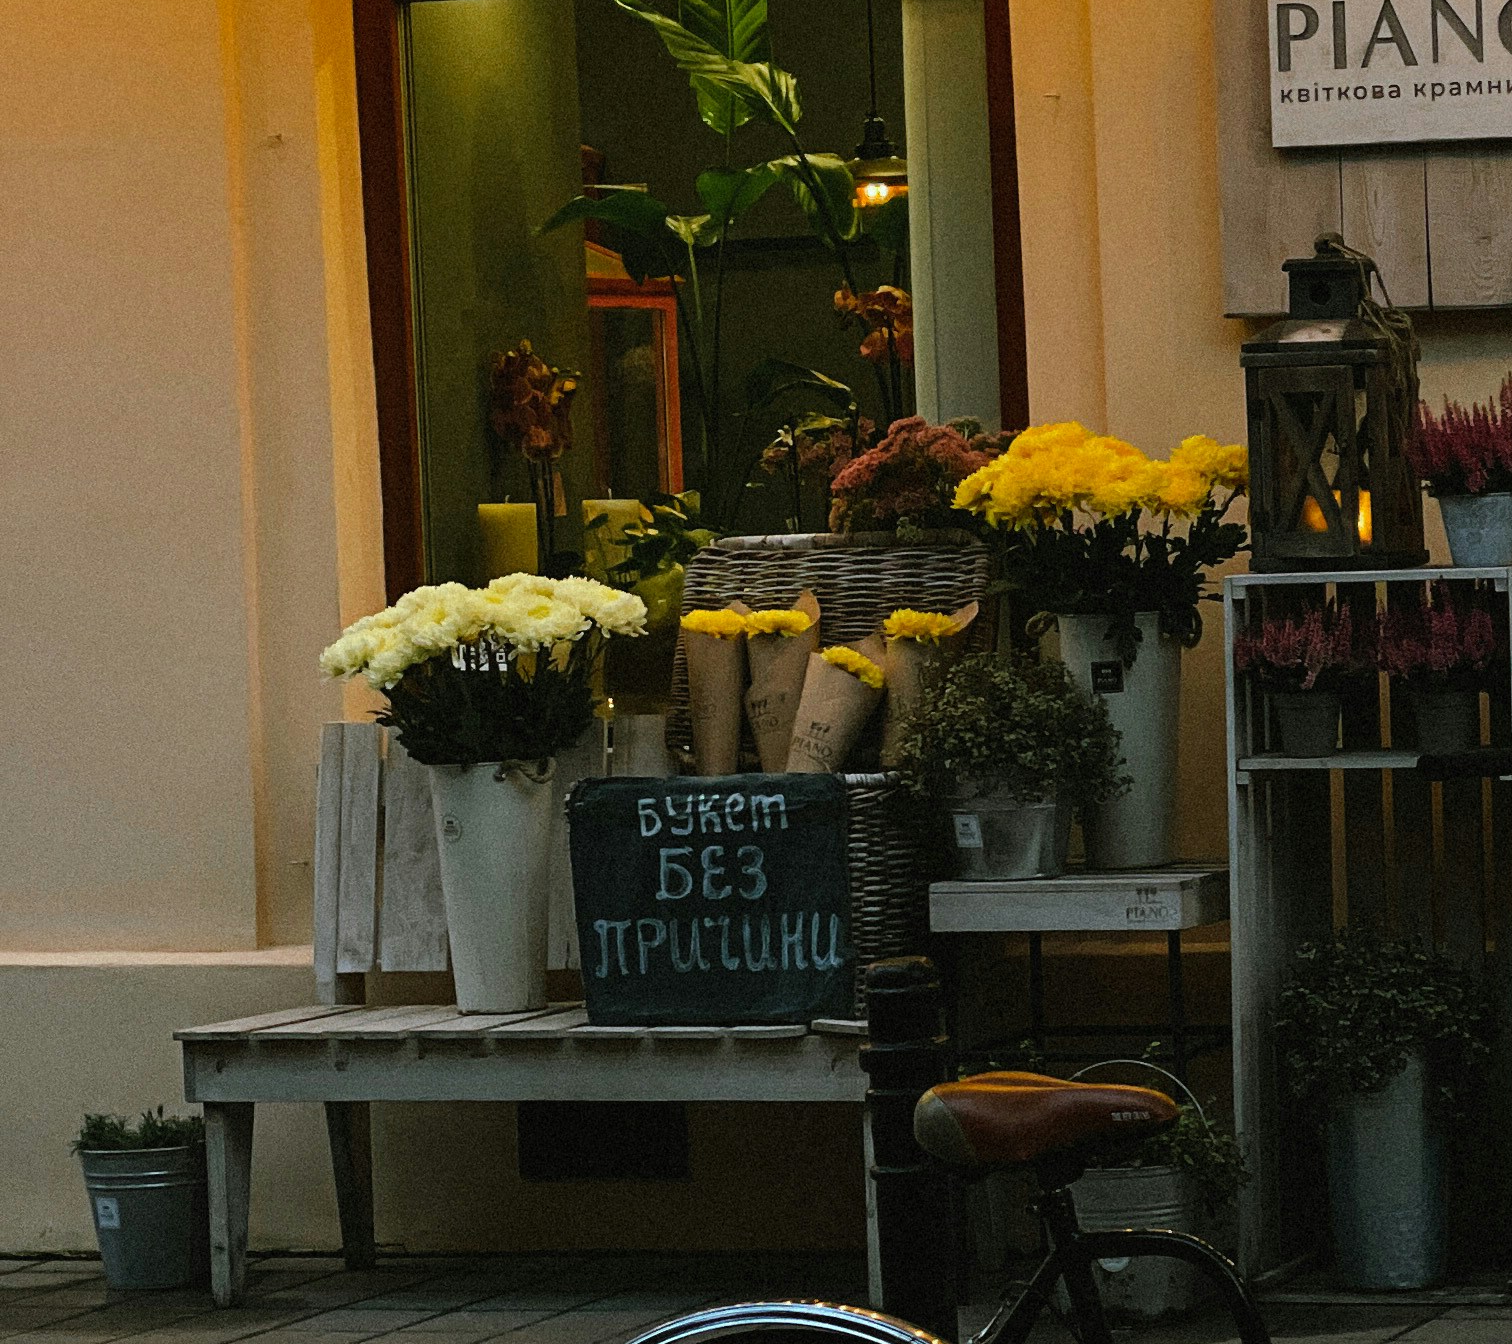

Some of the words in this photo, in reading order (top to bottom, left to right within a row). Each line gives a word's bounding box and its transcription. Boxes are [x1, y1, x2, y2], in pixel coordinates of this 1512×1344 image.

[1280, 81, 1401, 103] квіткова
[655, 845, 768, 900] БЕЗ
[593, 911, 844, 978] ПРИЧИНИ
